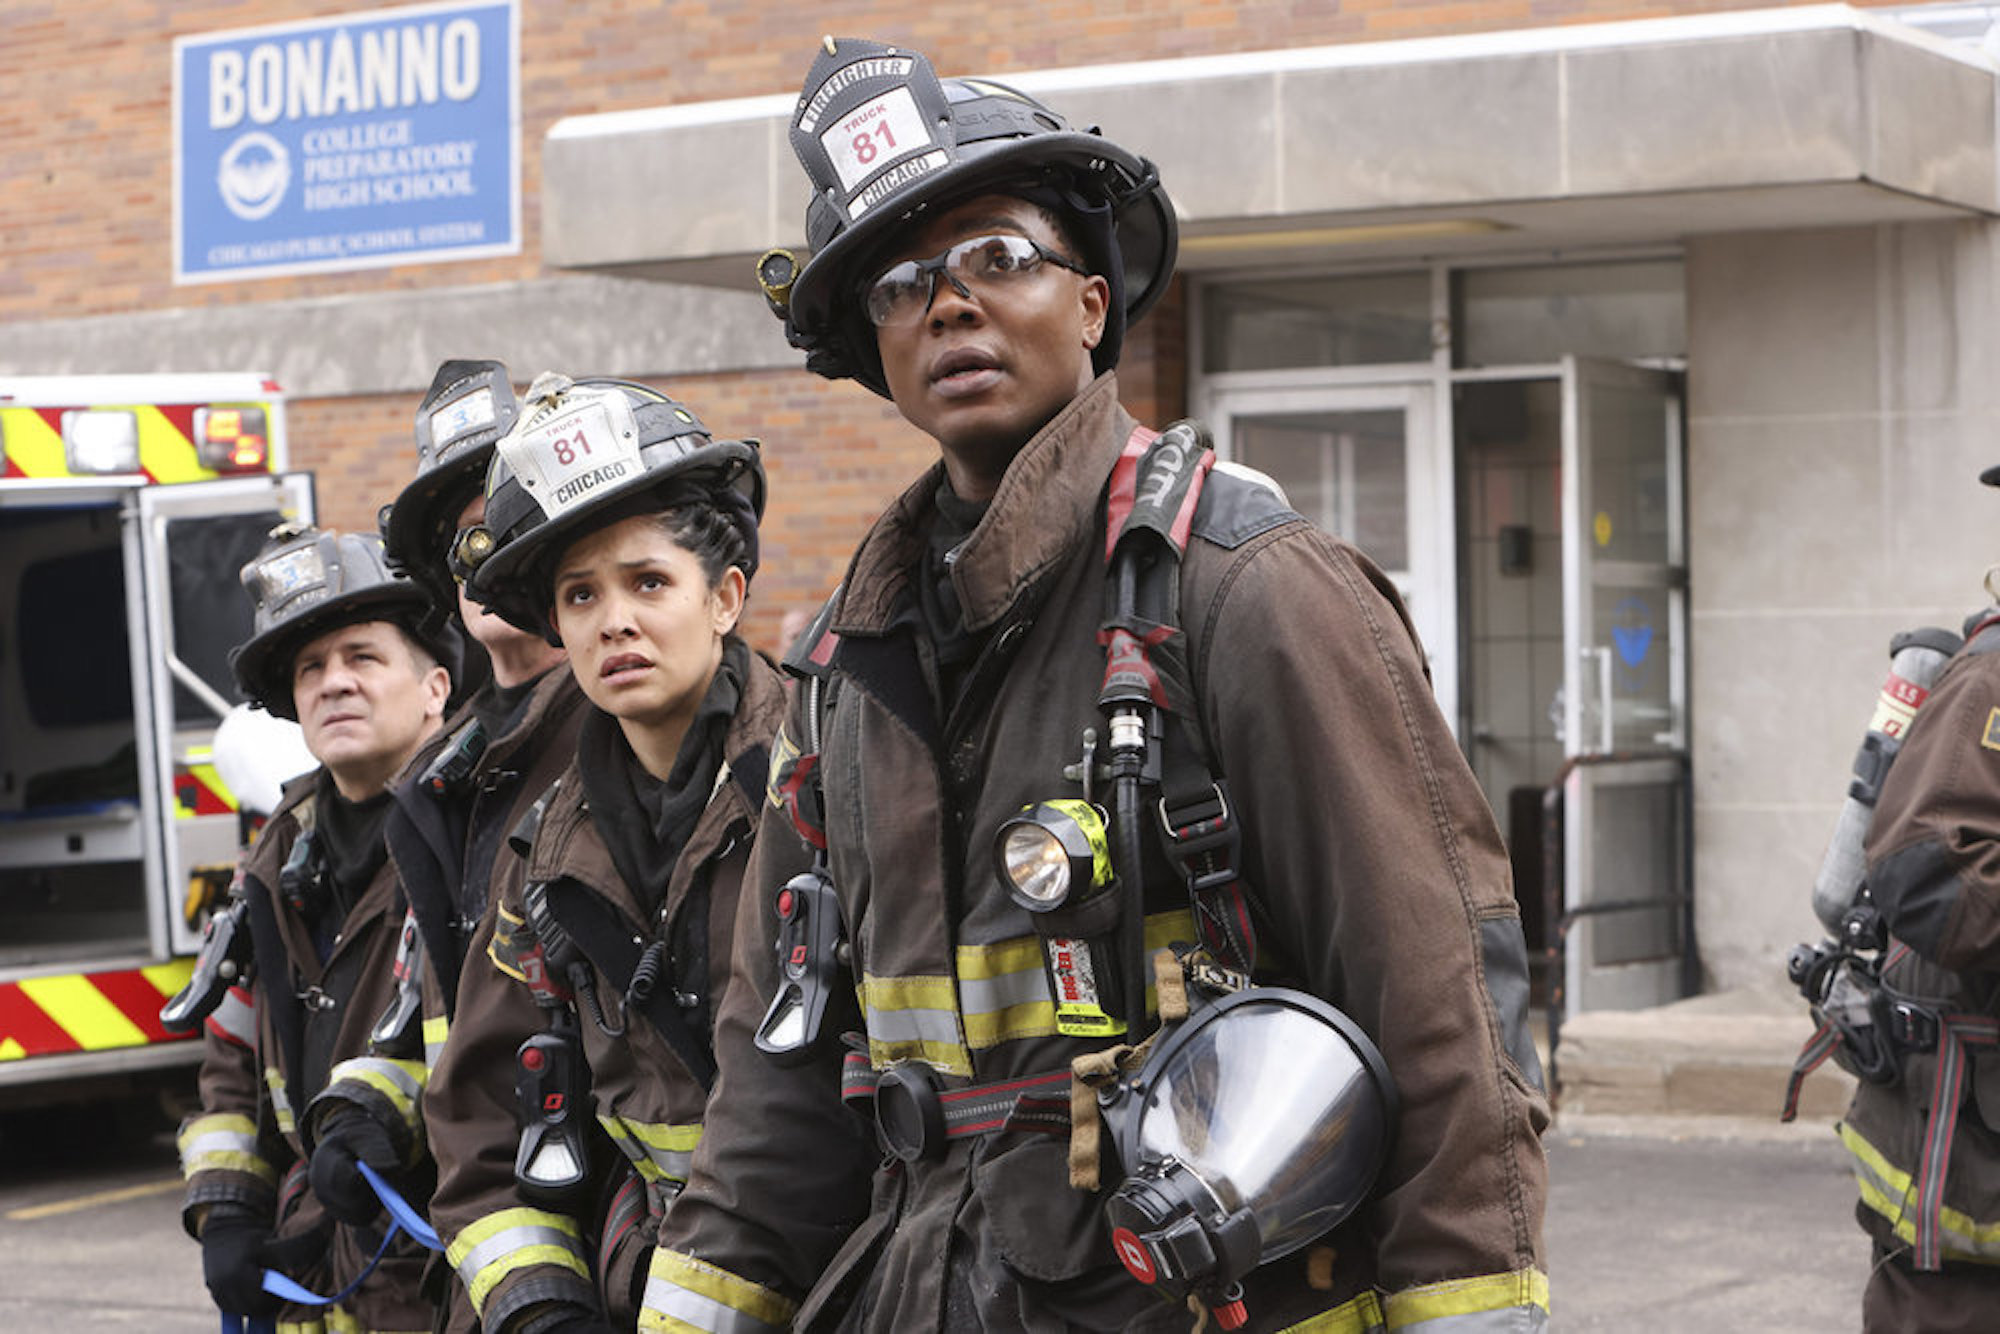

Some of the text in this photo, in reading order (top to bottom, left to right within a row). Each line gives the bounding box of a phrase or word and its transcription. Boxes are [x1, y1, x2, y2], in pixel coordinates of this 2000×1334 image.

[209, 19, 480, 129] BONANNO
[806, 60, 902, 123] FIREFIGHTER
[303, 120, 413, 155] COLLEGE
[843, 104, 887, 133] TRUCK
[304, 141, 477, 183] PREPARATORY
[852, 119, 897, 165] 81
[304, 170, 477, 211] HIGH SCHOOL
[862, 156, 931, 206] CHICAGO
[546, 416, 582, 437] TRUCK
[553, 430, 592, 466] 81
[556, 461, 627, 505] CHICAGO
